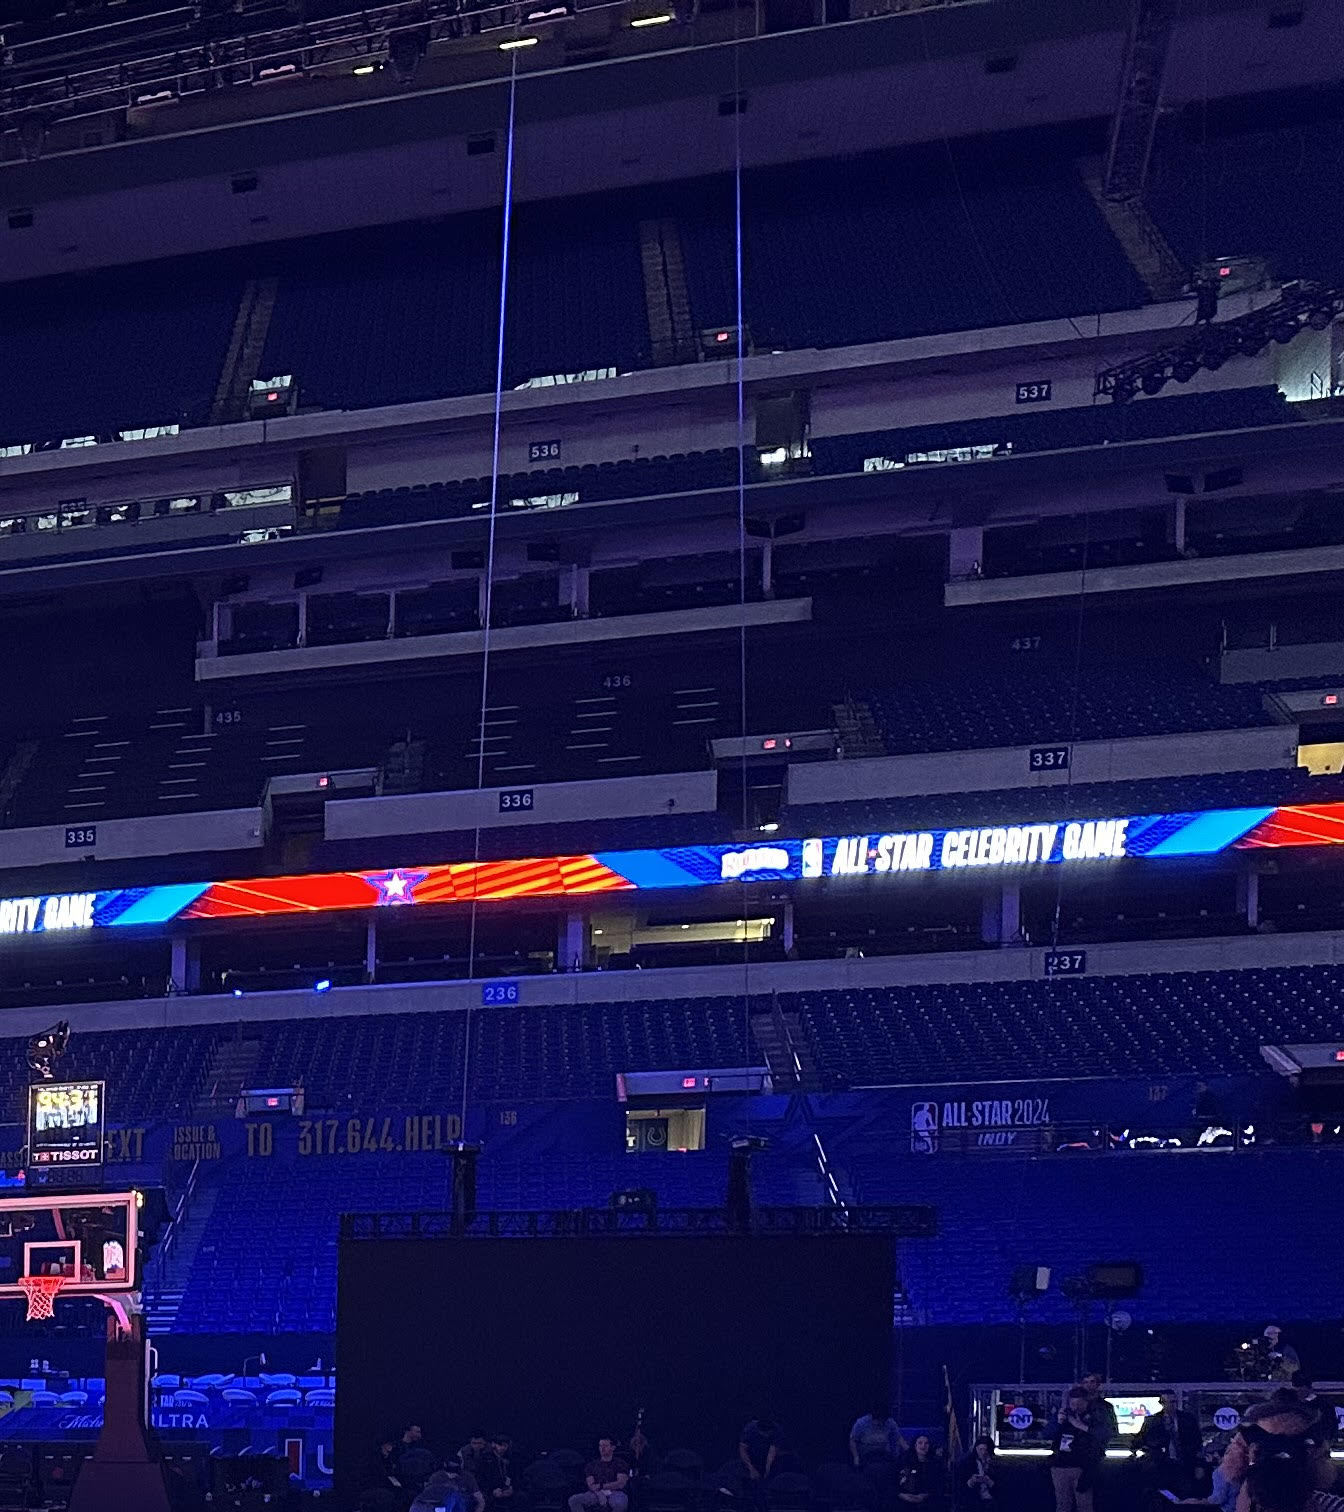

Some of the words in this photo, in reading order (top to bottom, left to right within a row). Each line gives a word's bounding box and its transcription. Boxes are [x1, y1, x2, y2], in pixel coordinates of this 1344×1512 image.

[1017, 384, 1049, 400] 537
[530, 446, 560, 459] 536
[1011, 635, 1042, 650] 437
[602, 675, 632, 688] 436
[215, 710, 242, 724] 435
[1032, 751, 1066, 767] 337
[501, 793, 532, 808] 336
[67, 830, 94, 845] 335
[941, 824, 1058, 866] CELEBRITY
[1062, 819, 1129, 861] GAME
[485, 985, 517, 1001] 236
[1014, 1098, 1050, 1125] 2024
[173, 1125, 207, 1143] ISSUE
[244, 1122, 273, 1157] TO
[977, 1131, 1018, 1146] INDY
[106, 1128, 146, 1164] EXT
[173, 1142, 222, 1162] OCATION
[50, 1149, 99, 1162] TISSOT
[1007, 1414, 1033, 1426] TNT
[1212, 1414, 1240, 1426] TNT
